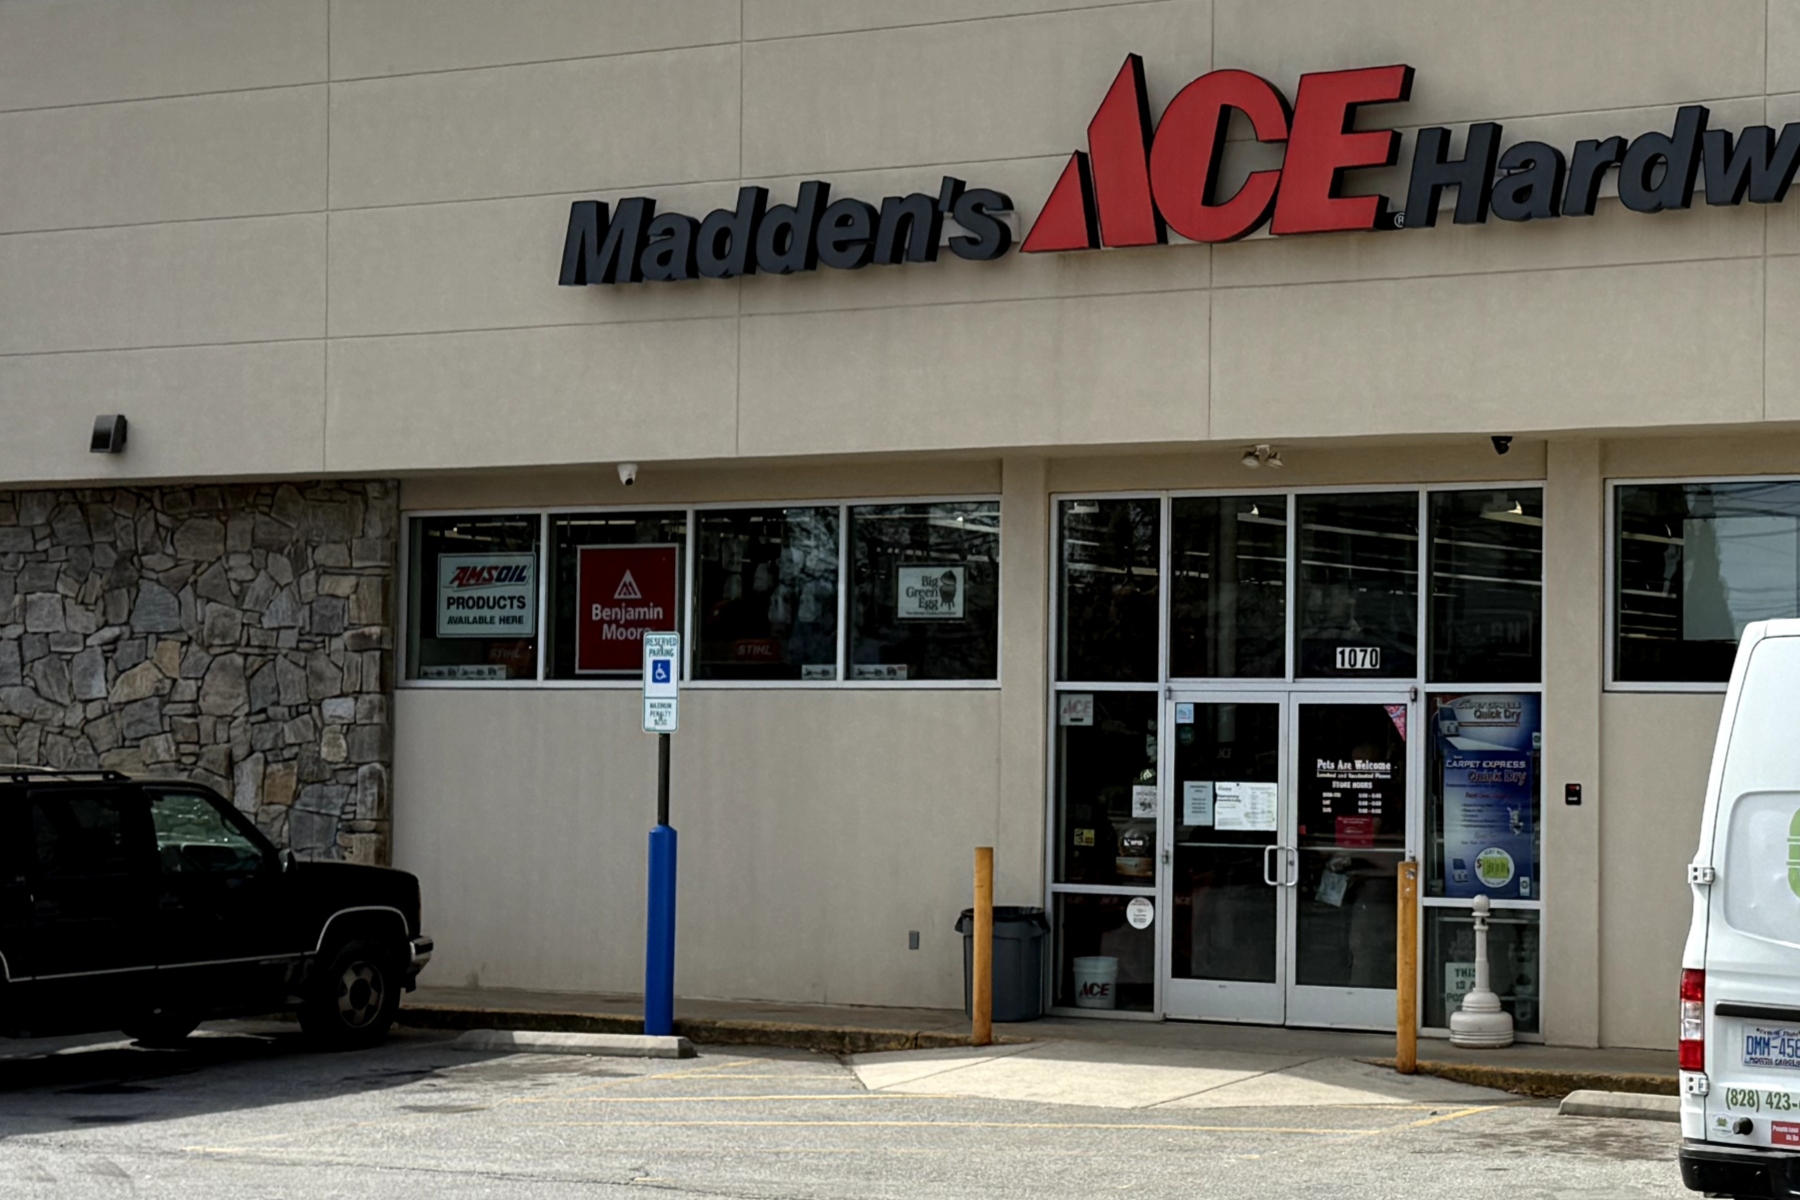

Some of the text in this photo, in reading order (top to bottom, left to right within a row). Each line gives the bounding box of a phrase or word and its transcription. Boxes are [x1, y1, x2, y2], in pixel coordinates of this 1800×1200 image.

[558, 52, 1800, 287] Madden's ACE Hardw
[449, 565, 529, 588] AMSOIL
[921, 575, 939, 589] Big
[906, 586, 939, 599] Green
[447, 596, 527, 610] PRODUCTS
[918, 598, 939, 611] Egg
[447, 615, 525, 626] AVAILABLE HERE
[592, 603, 663, 625] Benjamin
[649, 648, 675, 657] PARKING
[1338, 648, 1379, 668] 1070
[1473, 709, 1521, 723] Quick Dry
[1316, 758, 1391, 771] Pets Are Welcome
[1446, 760, 1526, 768] CARPET EXPRESS
[1468, 769, 1527, 786] Quick Dry
[1080, 981, 1111, 997] ACE
[1726, 1087, 1760, 1113] (828)
